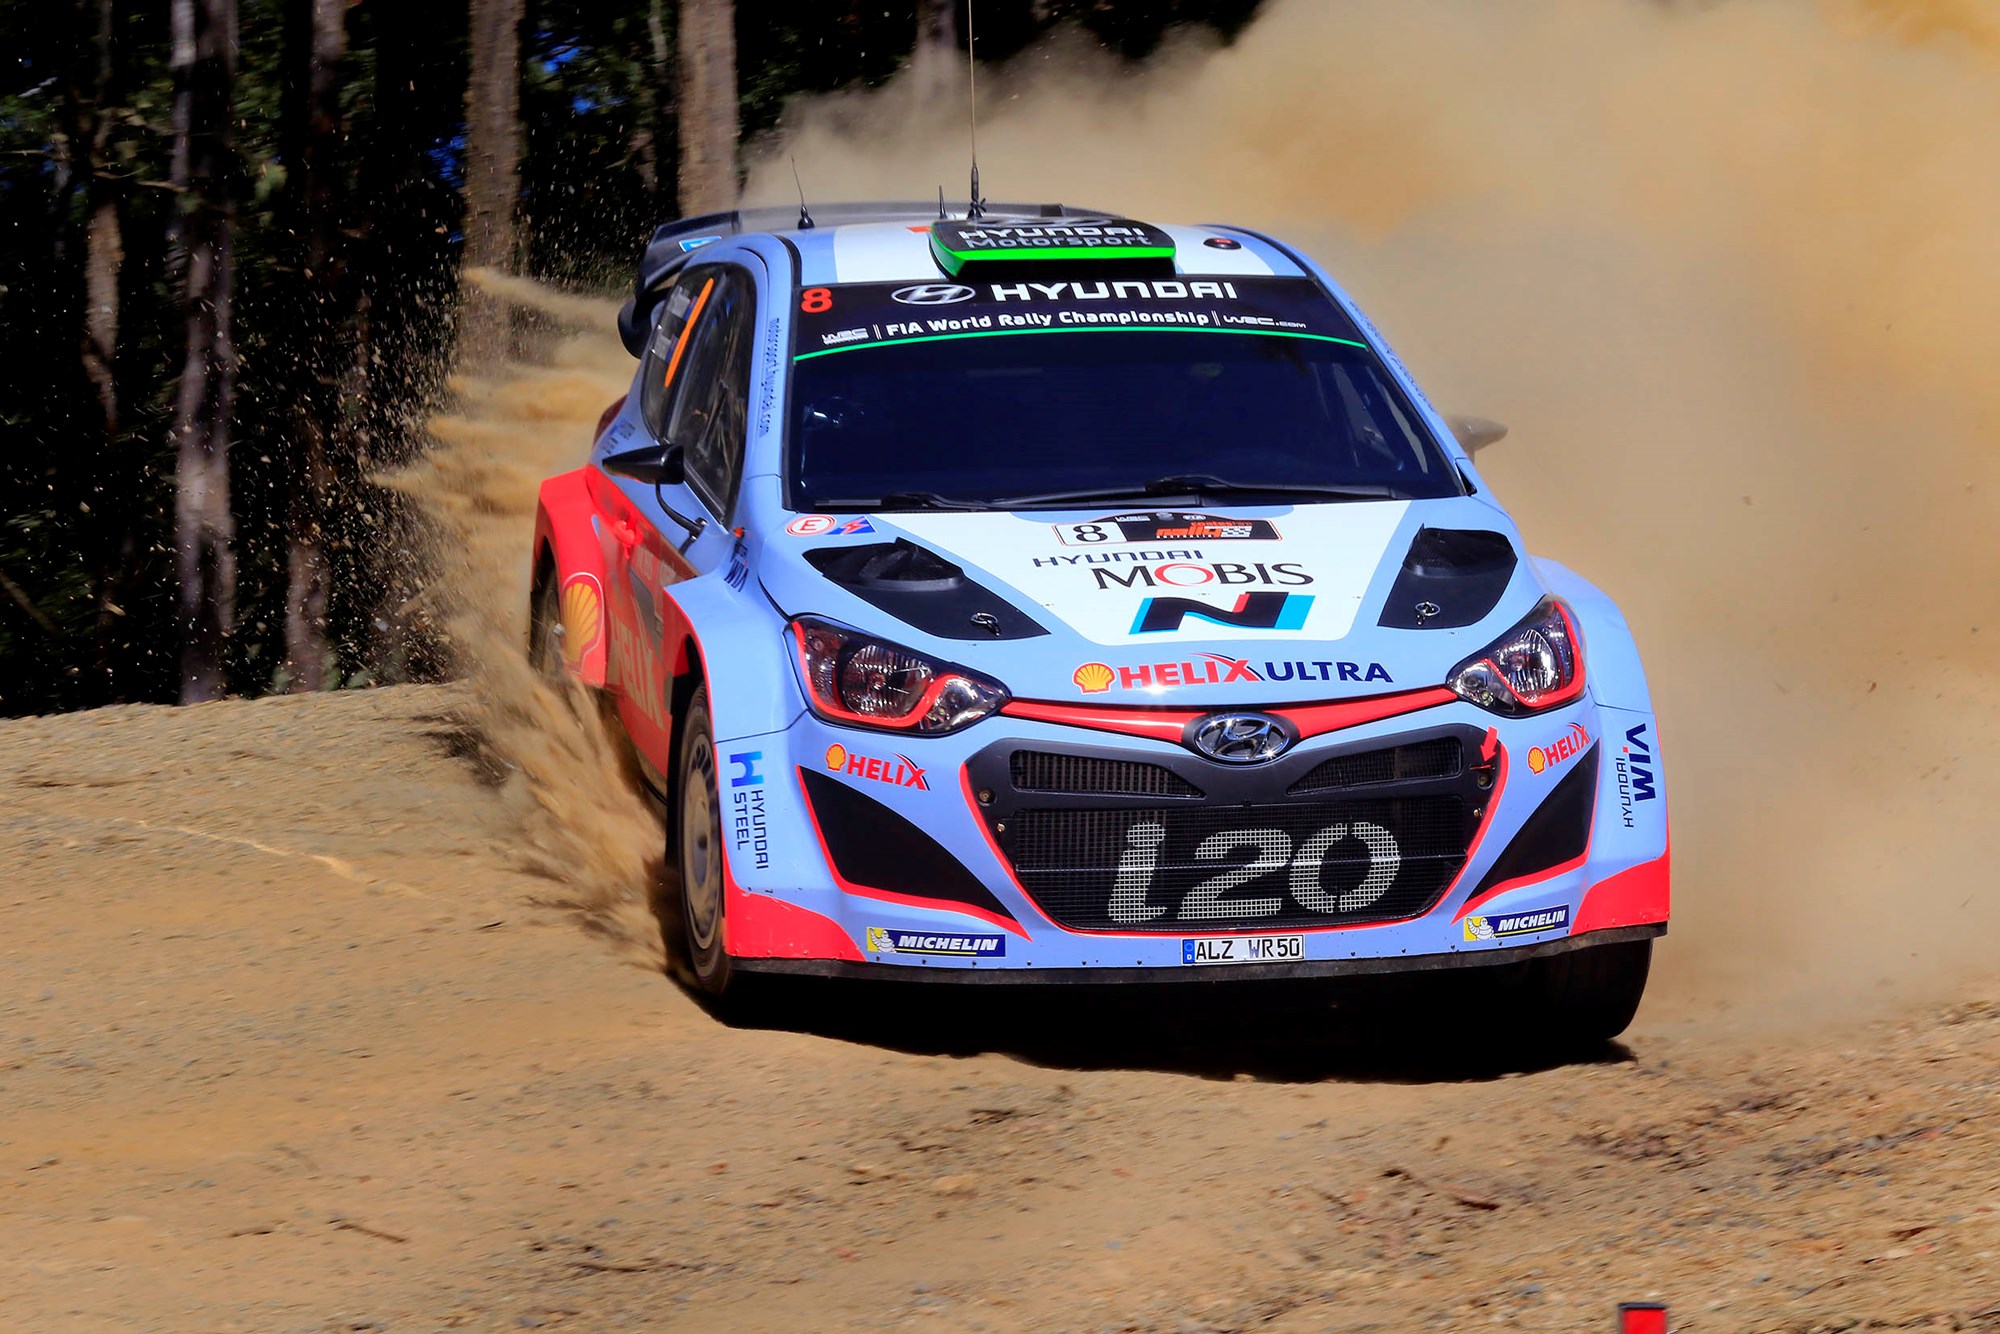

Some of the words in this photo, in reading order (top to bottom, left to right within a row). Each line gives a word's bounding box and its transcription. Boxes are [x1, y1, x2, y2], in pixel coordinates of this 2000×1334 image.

[958, 226, 1145, 239] HYUNDAI
[966, 235, 1152, 248] Motorsport
[801, 287, 832, 313] 8
[991, 281, 1238, 301] HYUNDAI
[886, 322, 924, 337] FIA
[926, 315, 992, 332] World
[999, 312, 1052, 327] Rally
[1058, 309, 1209, 326] Championship
[800, 519, 822, 531] E
[1072, 524, 1110, 543] 8
[1032, 550, 1204, 568] HYUNDAI
[1090, 563, 1314, 590] MOBIS
[1118, 654, 1262, 690] HELIX
[1263, 660, 1394, 683] ULTRA
[1543, 722, 1591, 768] HELIX
[847, 752, 931, 791] HELIX
[1626, 723, 1656, 802] WIA
[1616, 757, 1634, 828] HYUNDAI
[733, 792, 750, 851] STEEL
[751, 789, 769, 870] HYUNDAI
[1497, 909, 1567, 932] MICHELIN
[898, 935, 998, 951] MICHELIN
[1196, 940, 1234, 960] ALZ
